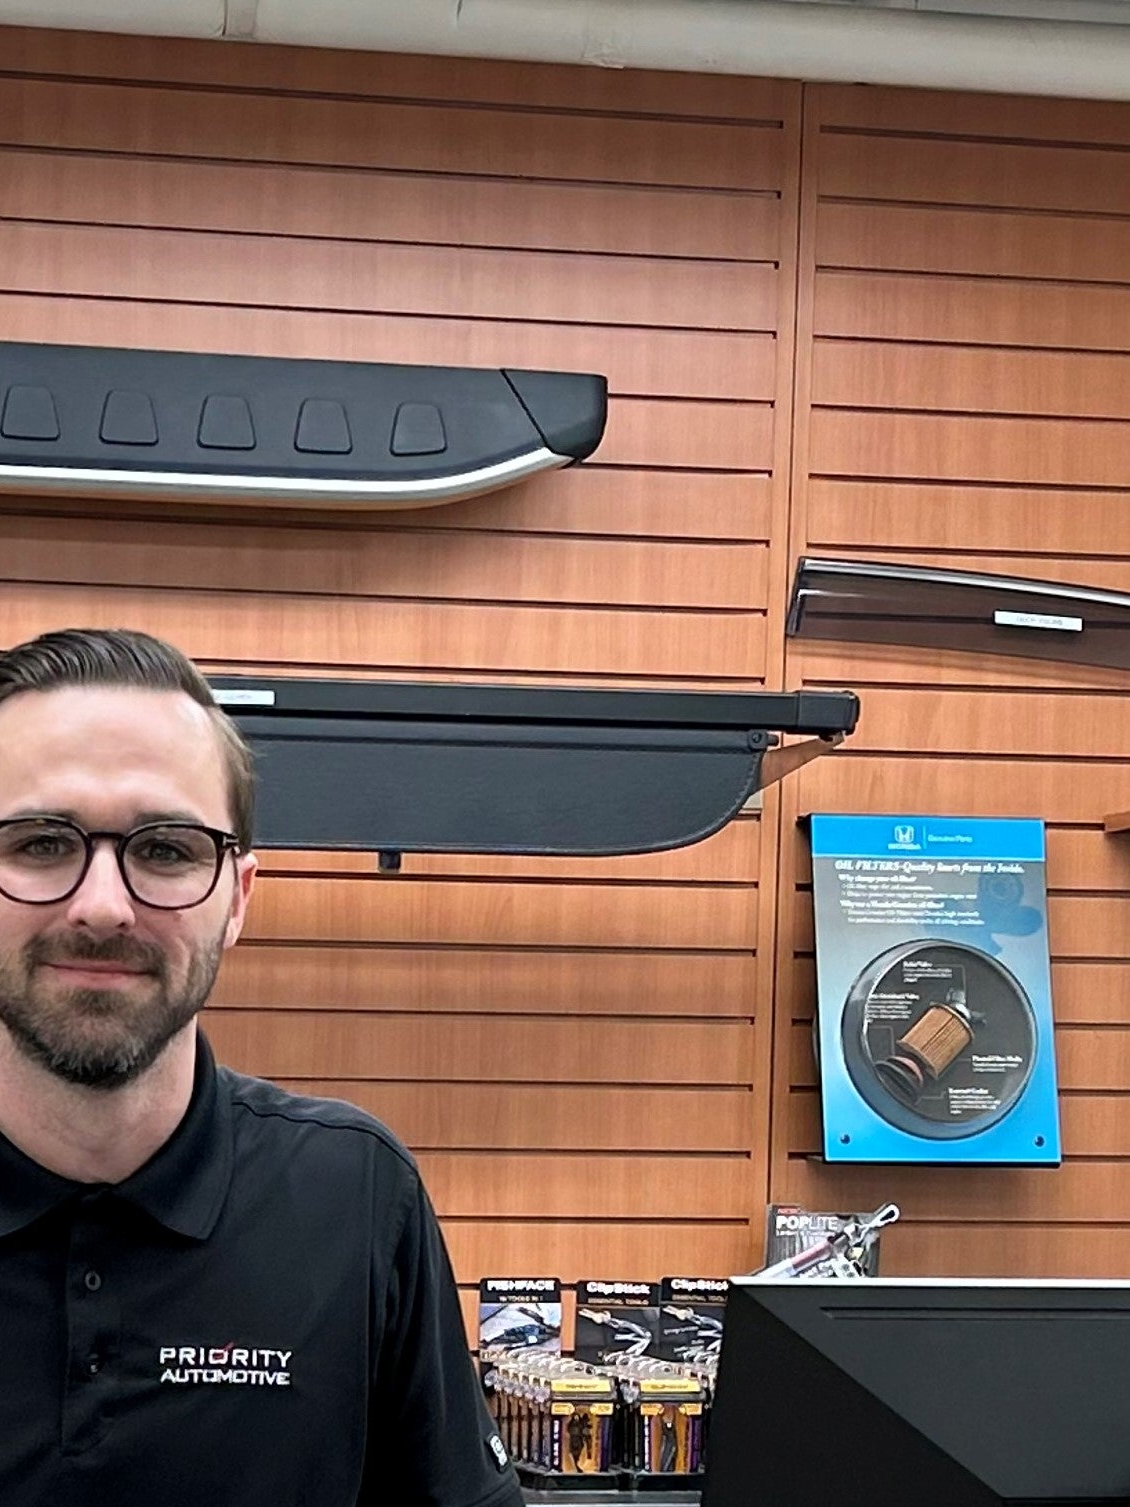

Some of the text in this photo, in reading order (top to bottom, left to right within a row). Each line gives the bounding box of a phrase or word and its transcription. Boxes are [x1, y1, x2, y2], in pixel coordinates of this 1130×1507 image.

[586, 1280, 651, 1296] ClipStick
[159, 1346, 292, 1368] PRIORITY
[160, 1369, 291, 1386] AUTOMOTIVE
